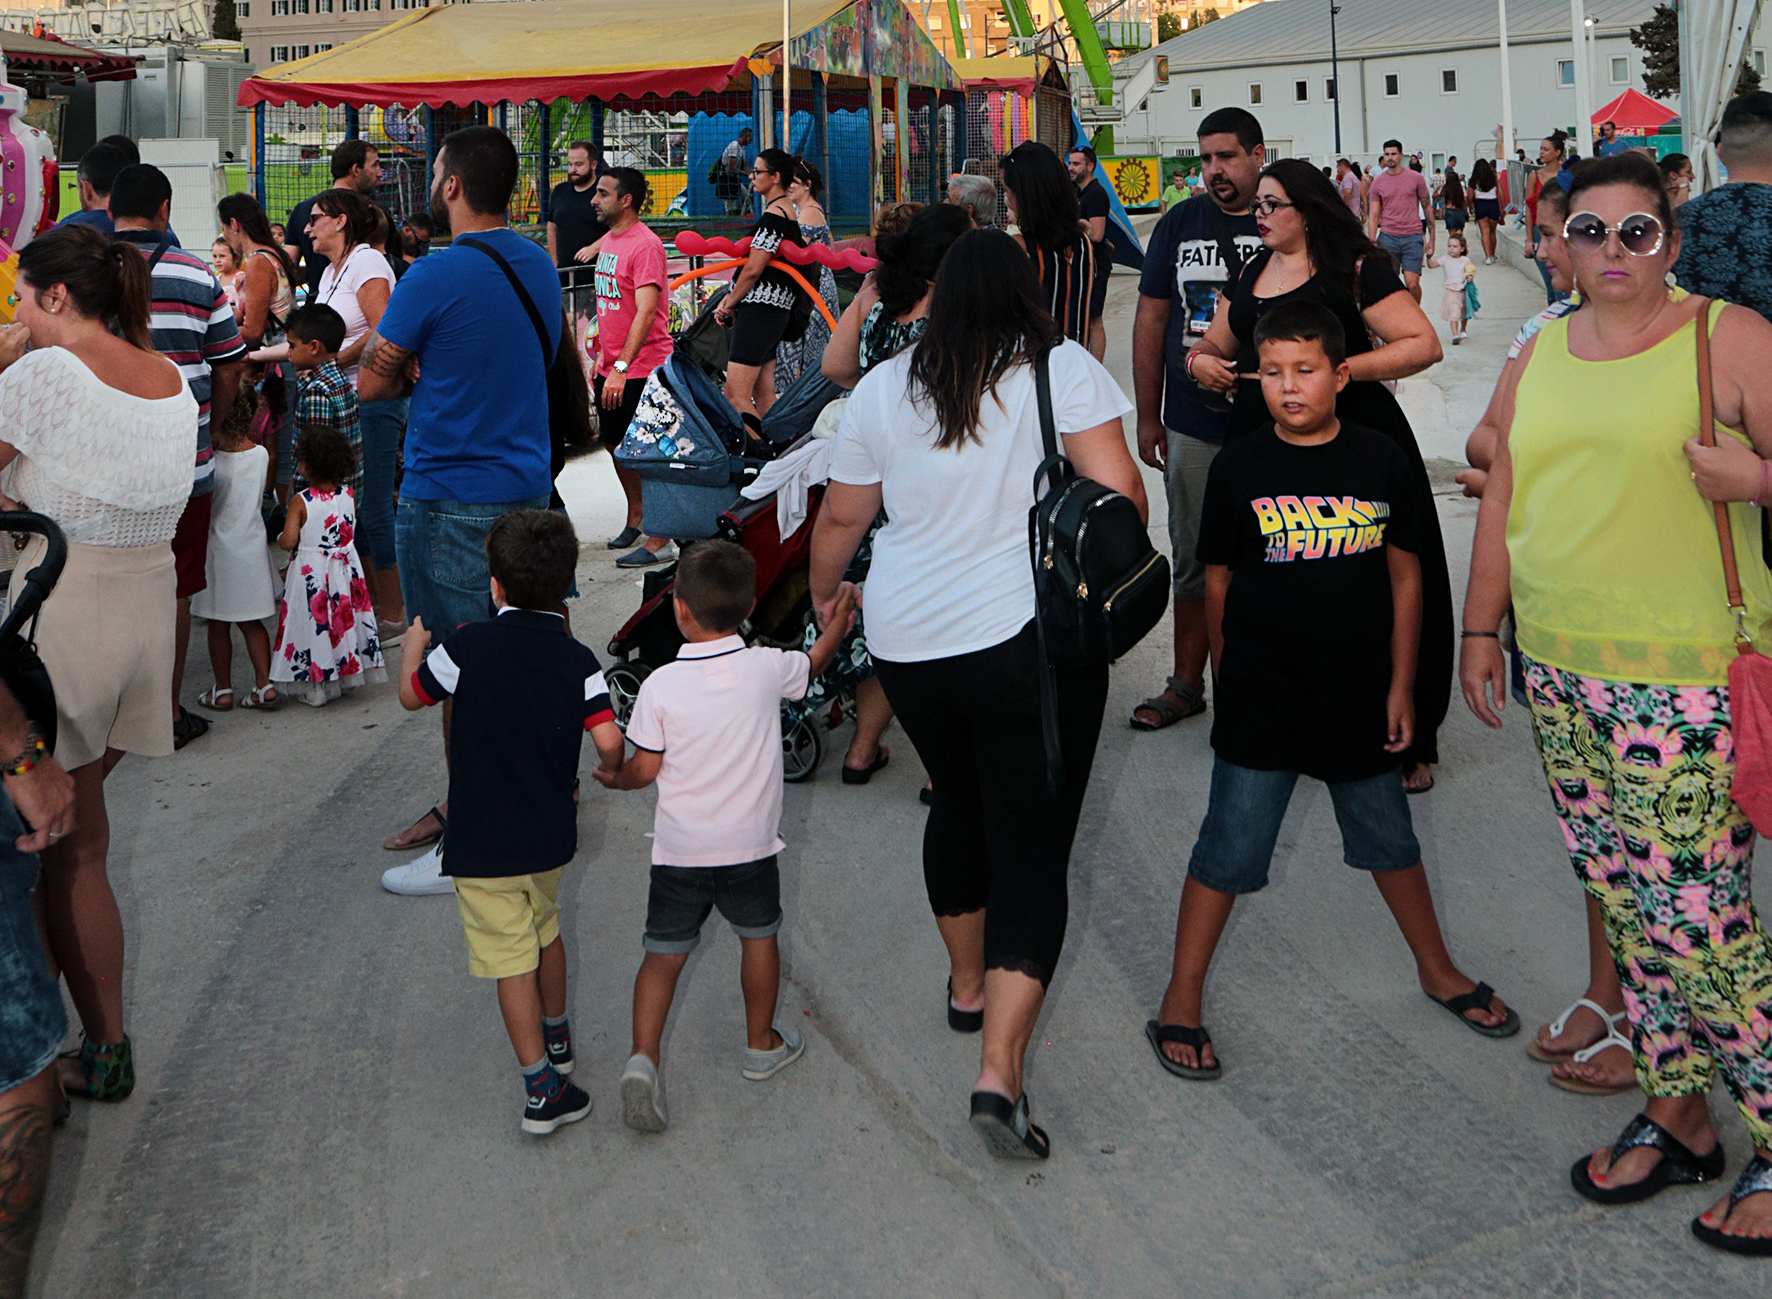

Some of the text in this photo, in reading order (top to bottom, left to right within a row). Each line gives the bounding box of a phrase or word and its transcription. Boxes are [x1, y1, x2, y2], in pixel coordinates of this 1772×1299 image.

[1180, 244, 1266, 268] FATR
[1250, 495, 1390, 536] BACK
[1264, 523, 1388, 563] THE FUTURE
[1266, 532, 1286, 548] TO
